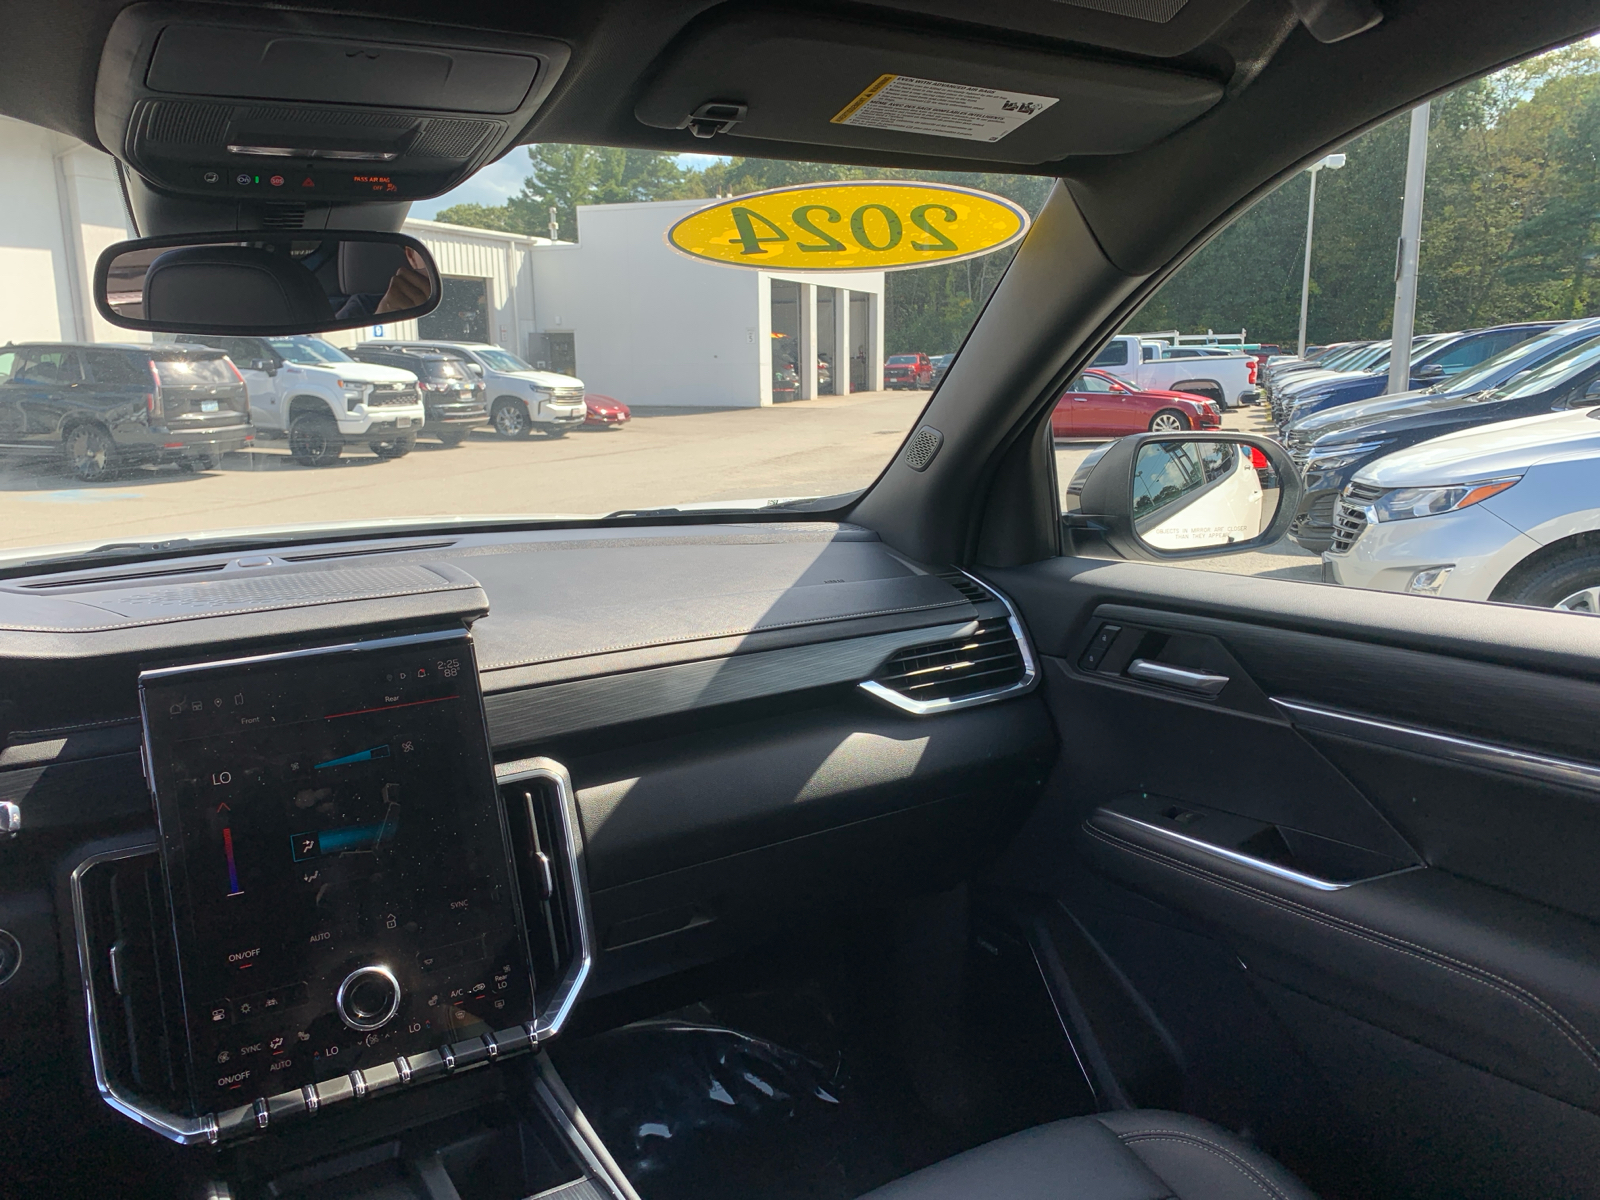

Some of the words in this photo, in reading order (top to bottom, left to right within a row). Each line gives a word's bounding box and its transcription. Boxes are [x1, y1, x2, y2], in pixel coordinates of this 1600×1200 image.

[436, 658, 460, 670] 2:25
[384, 695, 400, 703] Rear
[240, 716, 260, 725] Front
[212, 771, 232, 786] LO
[450, 899, 469, 909] SYNC
[309, 931, 331, 943] AUTO
[228, 947, 261, 963] ON/OFF
[494, 974, 508, 982] Rear
[497, 981, 508, 990] LO
[450, 988, 464, 998] A/C
[408, 1022, 421, 1034] LO
[240, 1043, 262, 1056] SYNC
[325, 1045, 339, 1057] LO
[269, 1059, 292, 1072] AUTO
[217, 1070, 251, 1086] ON/OFF
